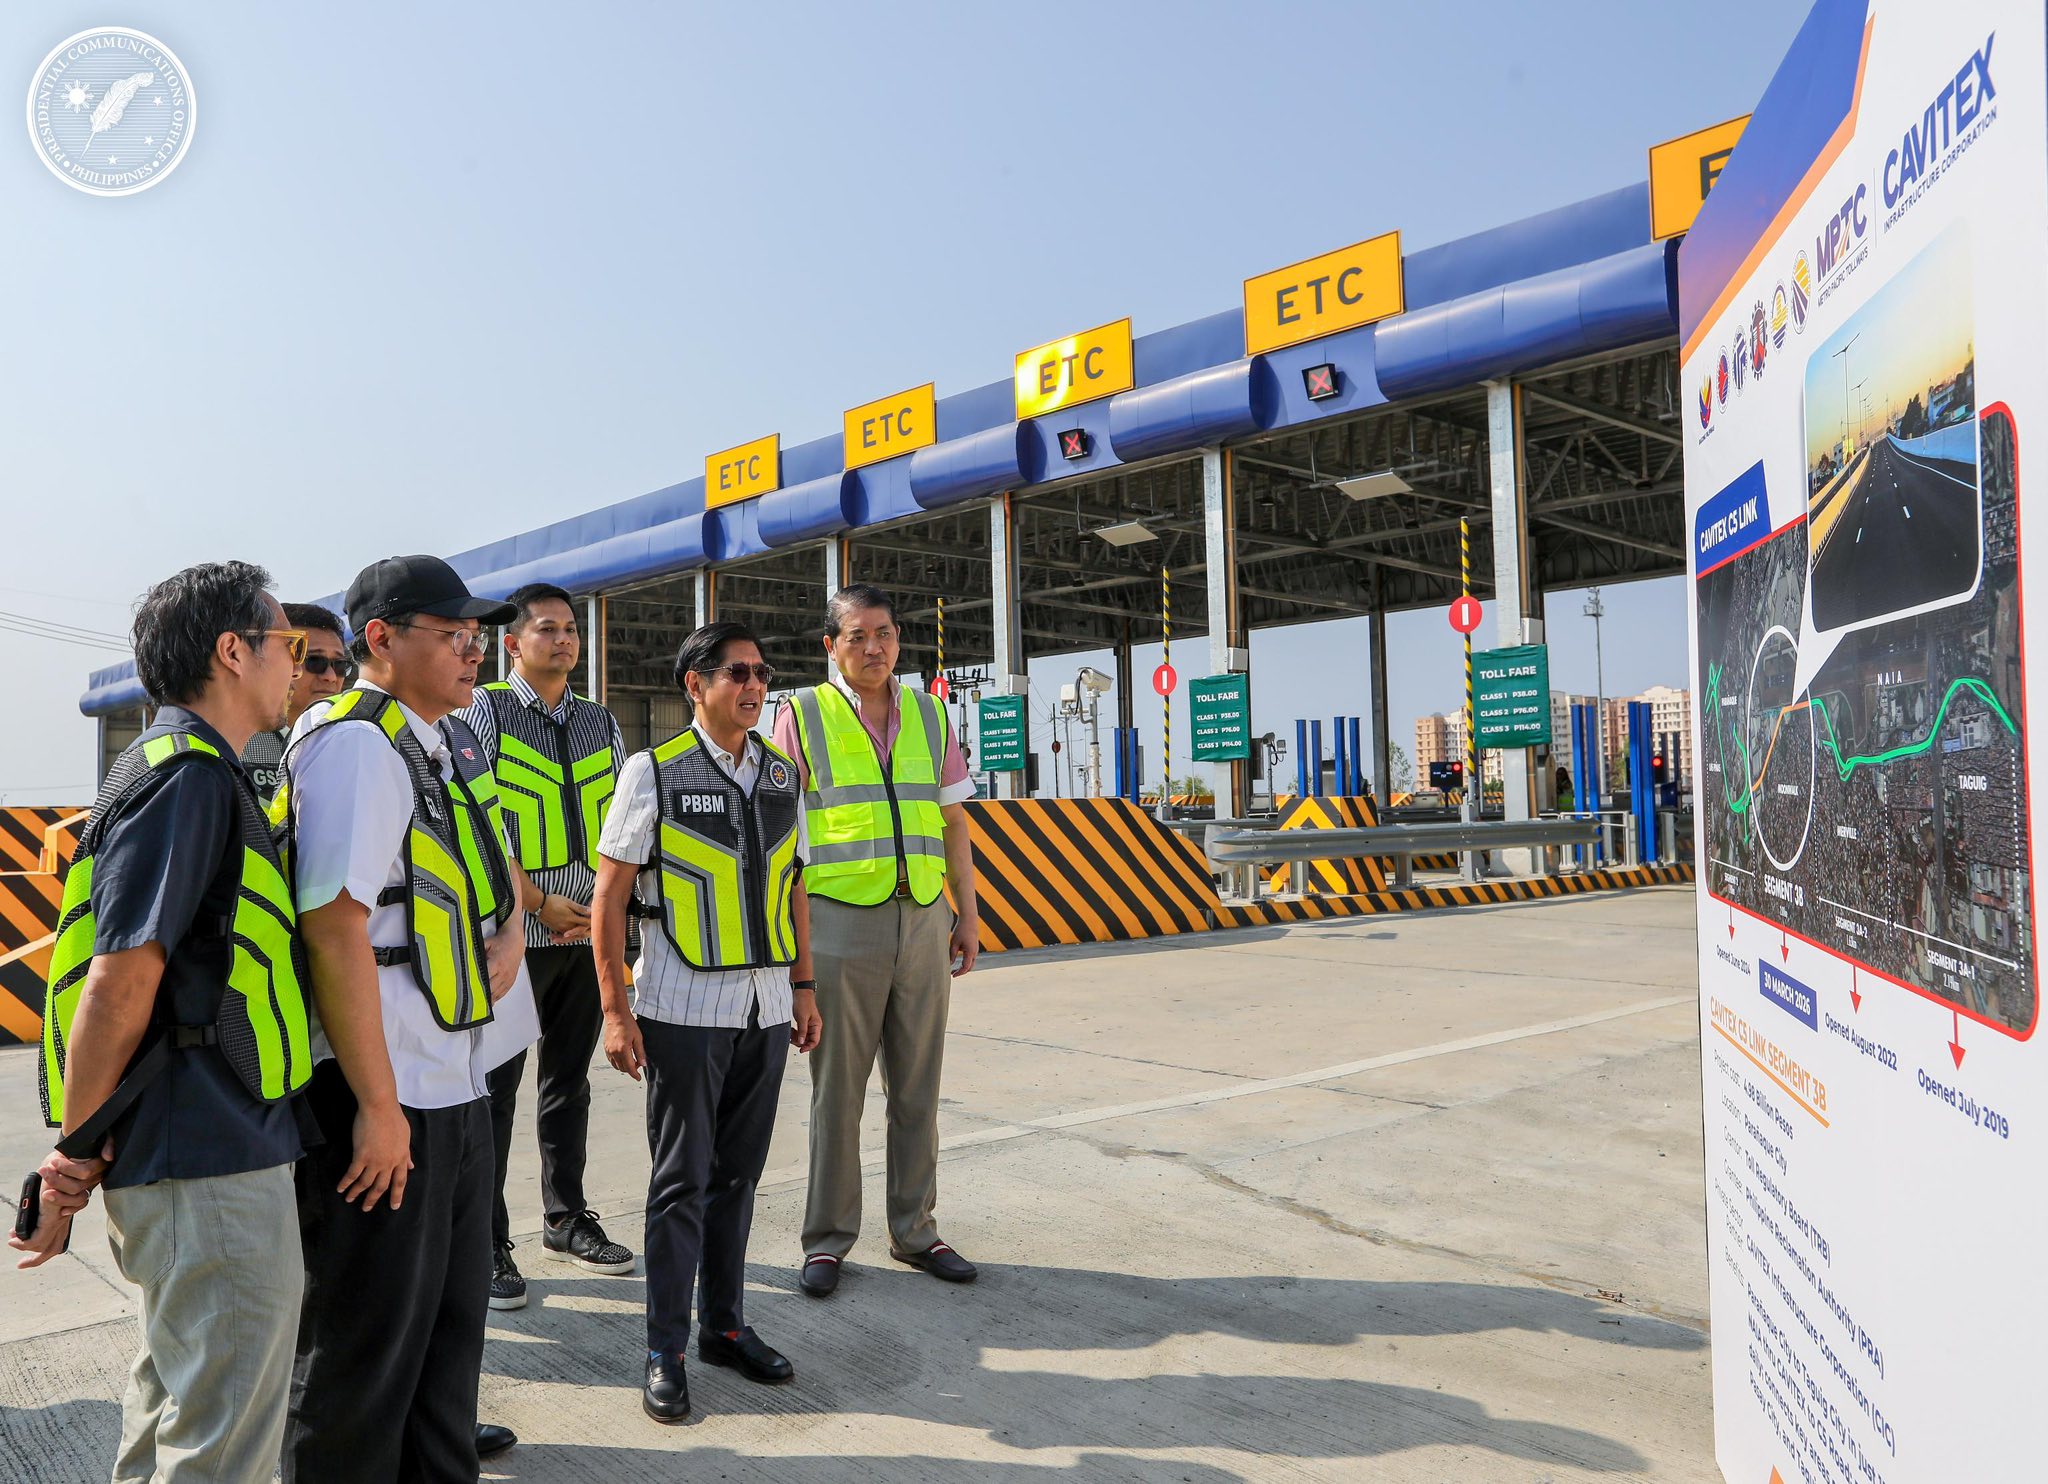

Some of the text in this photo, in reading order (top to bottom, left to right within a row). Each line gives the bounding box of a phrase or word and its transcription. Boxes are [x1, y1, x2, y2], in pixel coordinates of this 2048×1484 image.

[1883, 29, 1997, 209] CAVITEX
[1884, 106, 1997, 233] INFRASTRUCTURE CORPORATION
[1816, 183, 1867, 283] MPTC
[1276, 266, 1364, 327] ETC
[1039, 346, 1105, 395] ETC
[862, 406, 913, 449] ETC
[718, 455, 760, 490] ETC
[1700, 495, 1758, 554] CAVITEX C5 LINK
[1480, 665, 1537, 680] TOLL FARE
[1877, 670, 1903, 686] NAIA
[1000, 710, 1017, 719] FARE
[1196, 691, 1239, 703] TOLL FARE
[1480, 692, 1503, 701] CLASS
[1512, 689, 1538, 698] P38.00
[1480, 709, 1503, 718] CLASS
[1481, 726, 1504, 734] CLASS
[1514, 723, 1541, 732] P114.00
[253, 768, 279, 786] GS
[1958, 774, 1988, 791] TAGUIG
[681, 794, 725, 813] PBBM
[1764, 873, 1793, 903] SEGMENT
[1794, 884, 1804, 907] 3B
[1835, 915, 1856, 934] SEGMENT
[1927, 949, 1976, 980] SEGMENT 3A-1
[1764, 971, 1811, 1016] 30 MARCH 2026
[1710, 995, 1827, 1112] CAVITEX C5 LINK SEGMENT 3B
[1825, 1012, 1898, 1072] Opened August 2022
[1918, 1068, 2009, 1140] Opened July 2019
[1775, 1107, 1794, 1141] Pesos
[1775, 1145, 1788, 1177] City
[1745, 1149, 1755, 1175] Toll
[1755, 1161, 1788, 1217] Regulatory
[1788, 1199, 1809, 1239] Board
[1810, 1224, 1831, 1269] (TRB)
[1745, 1185, 1774, 1235] Philippine
[1774, 1222, 1817, 1290] Reclamation
[1817, 1277, 1856, 1343] Authority
[1858, 1325, 1885, 1381] (PRA)
[1746, 1234, 1771, 1280] CAVITEX
[1771, 1266, 1818, 1346] Infrastructure
[1819, 1334, 1870, 1417] Corporation
[1872, 1402, 1896, 1458] (CIC)
[1763, 1335, 1776, 1368] thru
[1776, 1357, 1806, 1416] CAVITEX
[1807, 1404, 1816, 1430] to
[1778, 1329, 1793, 1365] City
[1793, 1350, 1801, 1375] to
[1802, 1362, 1828, 1420] Taguig
[1829, 1404, 1846, 1446] City
[1847, 1426, 1857, 1459] in
[1858, 1442, 1876, 1484] just
[1764, 1370, 1794, 1428] connects
[1794, 1413, 1808, 1453] key
[1809, 1442, 1830, 1484] areas
[1782, 1428, 1795, 1461] and
